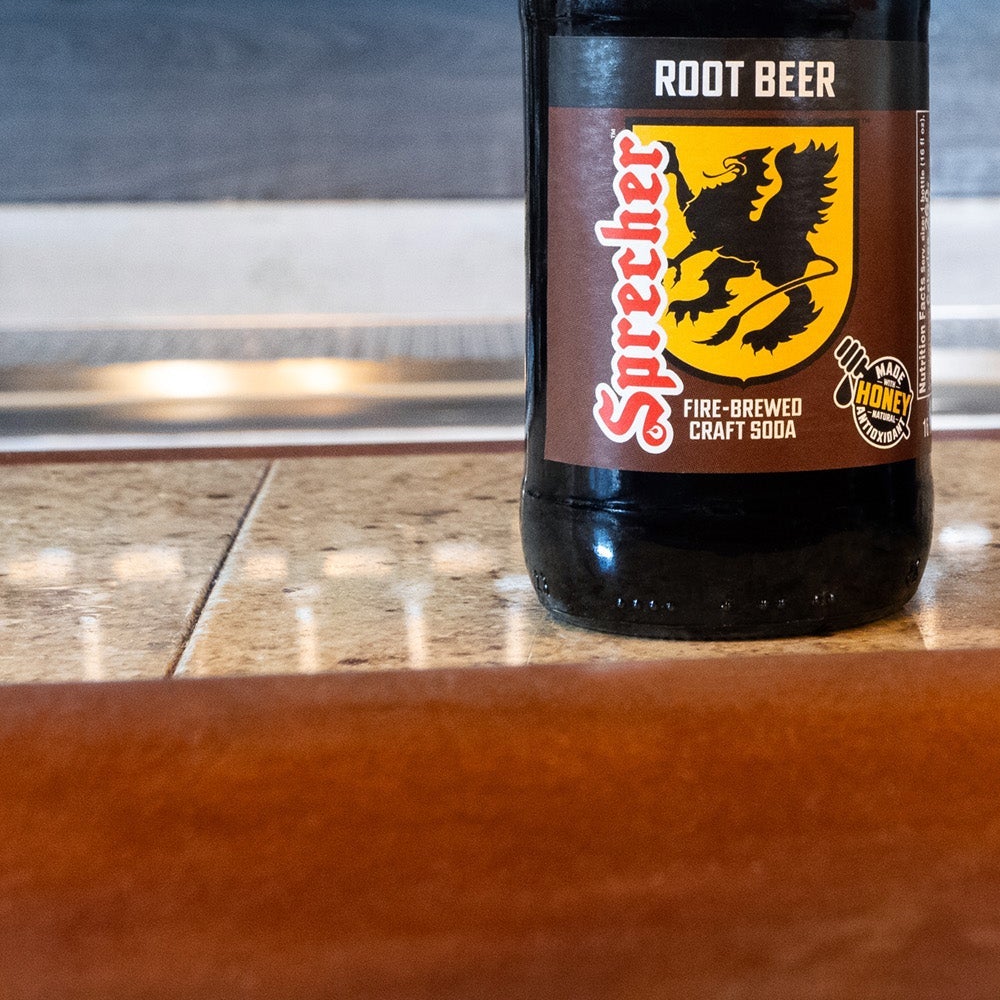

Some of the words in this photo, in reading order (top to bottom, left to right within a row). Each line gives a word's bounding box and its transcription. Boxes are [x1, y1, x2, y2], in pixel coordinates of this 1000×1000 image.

[655, 60, 745, 97] ROOT
[755, 61, 836, 97] BEER
[593, 129, 684, 454] Sprecher
[875, 361, 906, 385] MADE
[683, 397, 803, 418] FIRE-BREWED
[855, 380, 911, 416] HONEY
[689, 420, 746, 441] CRAFT
[750, 419, 797, 440] SODA
[856, 406, 905, 443] ANTIOXIDANT
[871, 409, 896, 424] NATURAL
